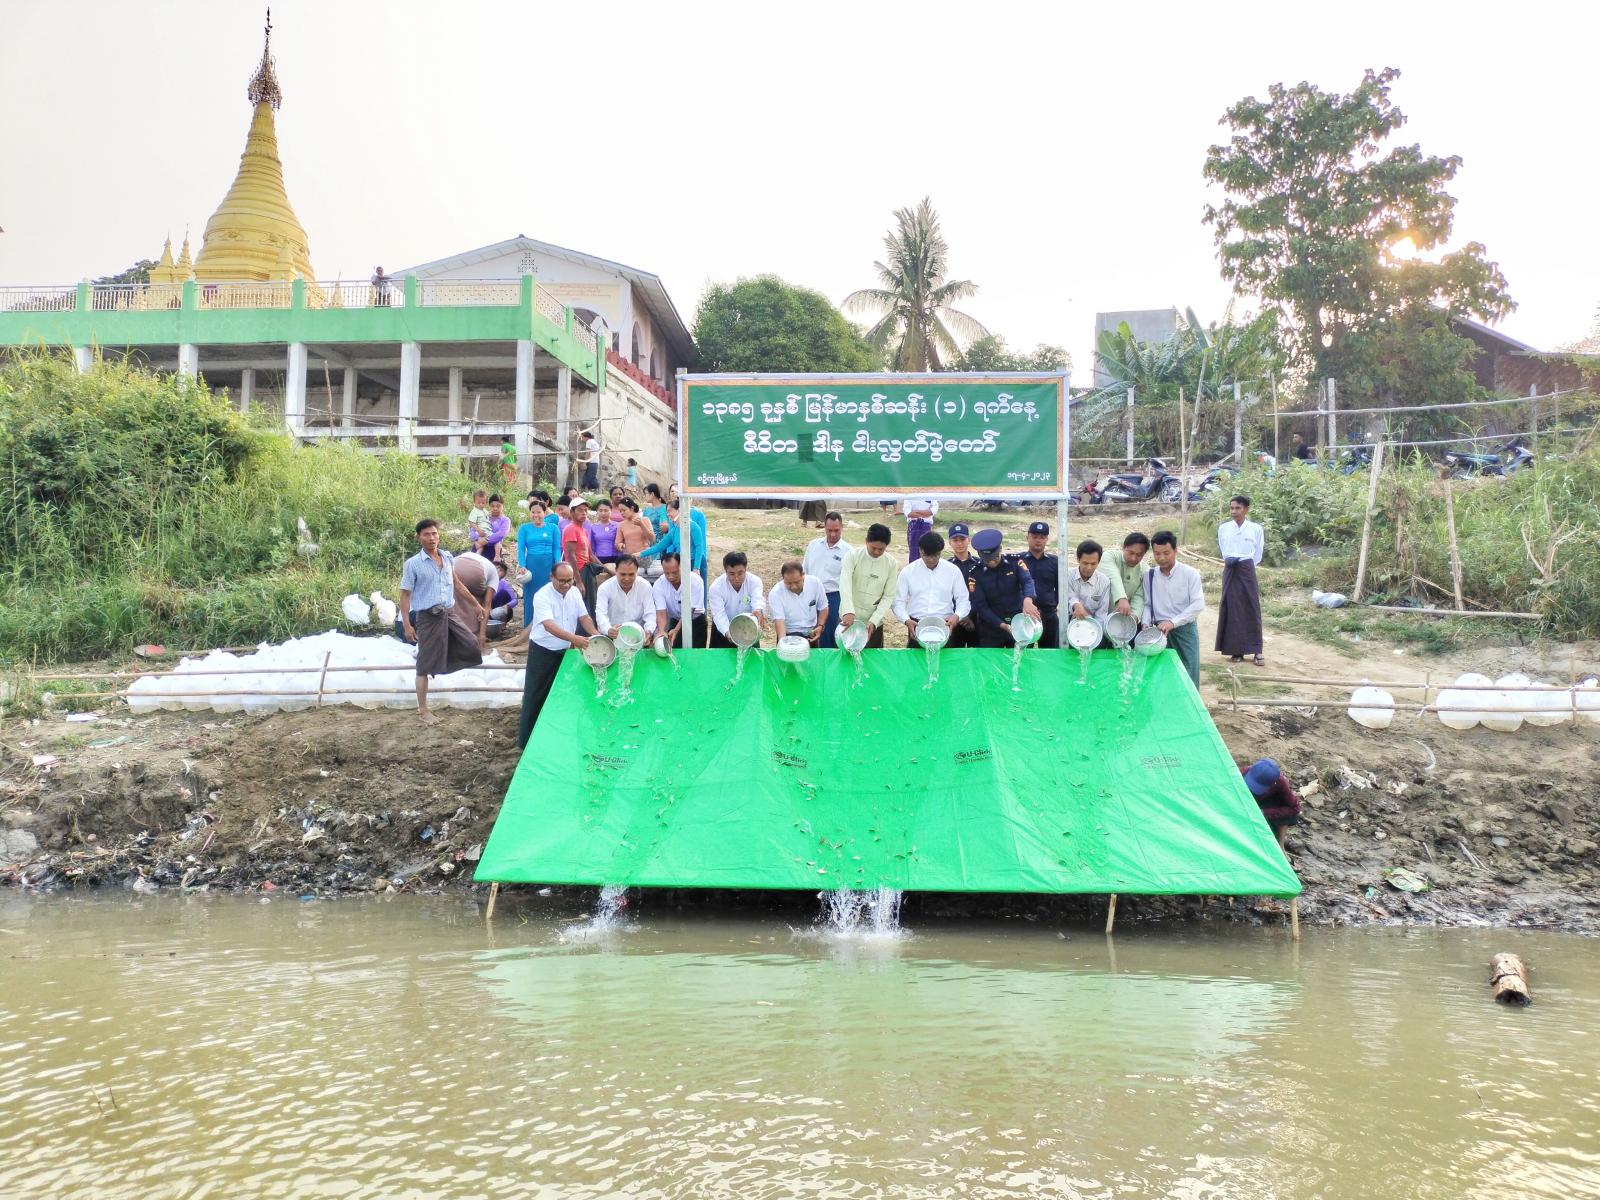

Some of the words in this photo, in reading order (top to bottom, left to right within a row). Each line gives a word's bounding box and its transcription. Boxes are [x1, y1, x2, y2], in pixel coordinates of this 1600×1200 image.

[702, 402, 754, 423] ၁၃၈၅
[760, 393, 802, 423] ခုနှစ်
[805, 393, 927, 422] မြန်မာနှစ်ဆန်း
[973, 393, 1040, 422] ရက်နေ့
